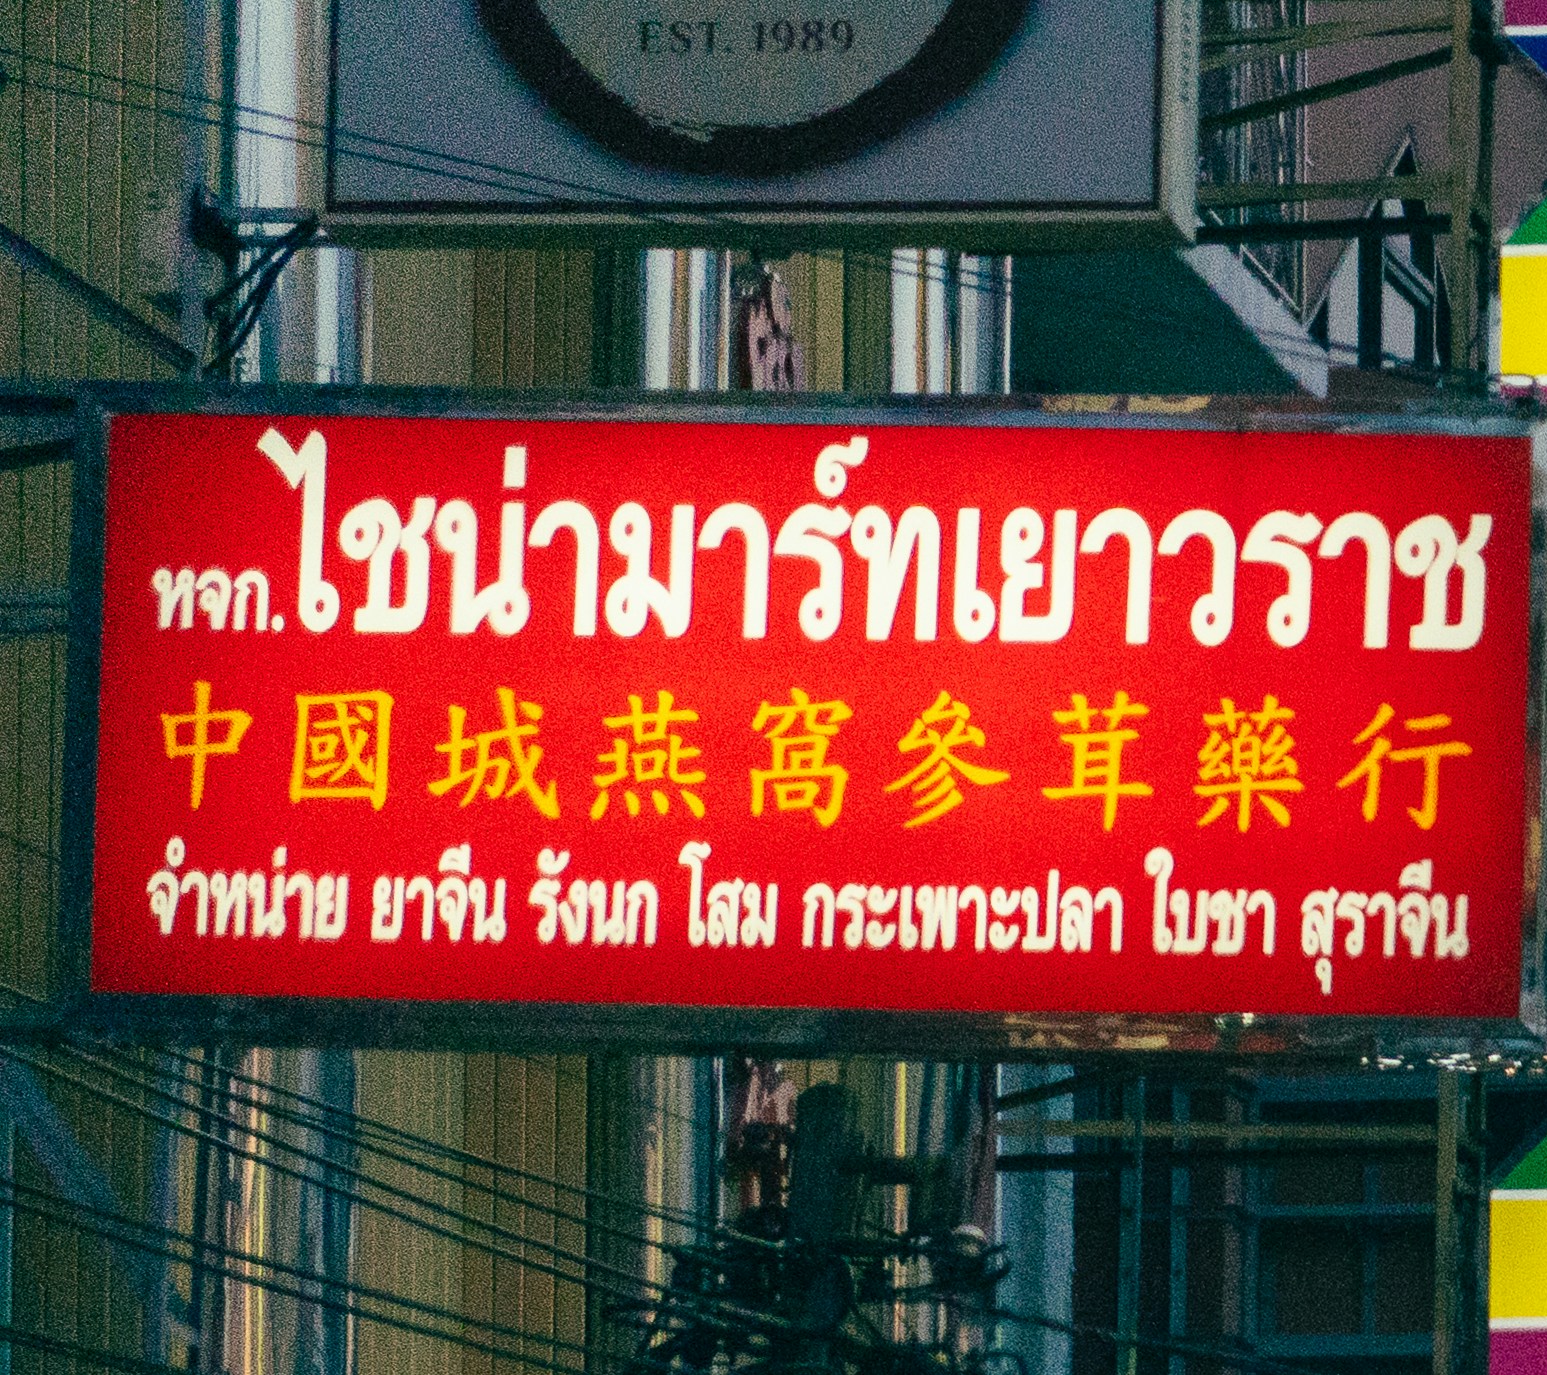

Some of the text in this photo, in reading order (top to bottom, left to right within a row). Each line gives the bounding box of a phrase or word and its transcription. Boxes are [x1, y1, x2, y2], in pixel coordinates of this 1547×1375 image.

[638, 19, 856, 53] EST. 1989
[147, 836, 1470, 995] จำหน่าย ยาจีน รังนก โสม กระเพาะปลา ใบชา สุราจีน
